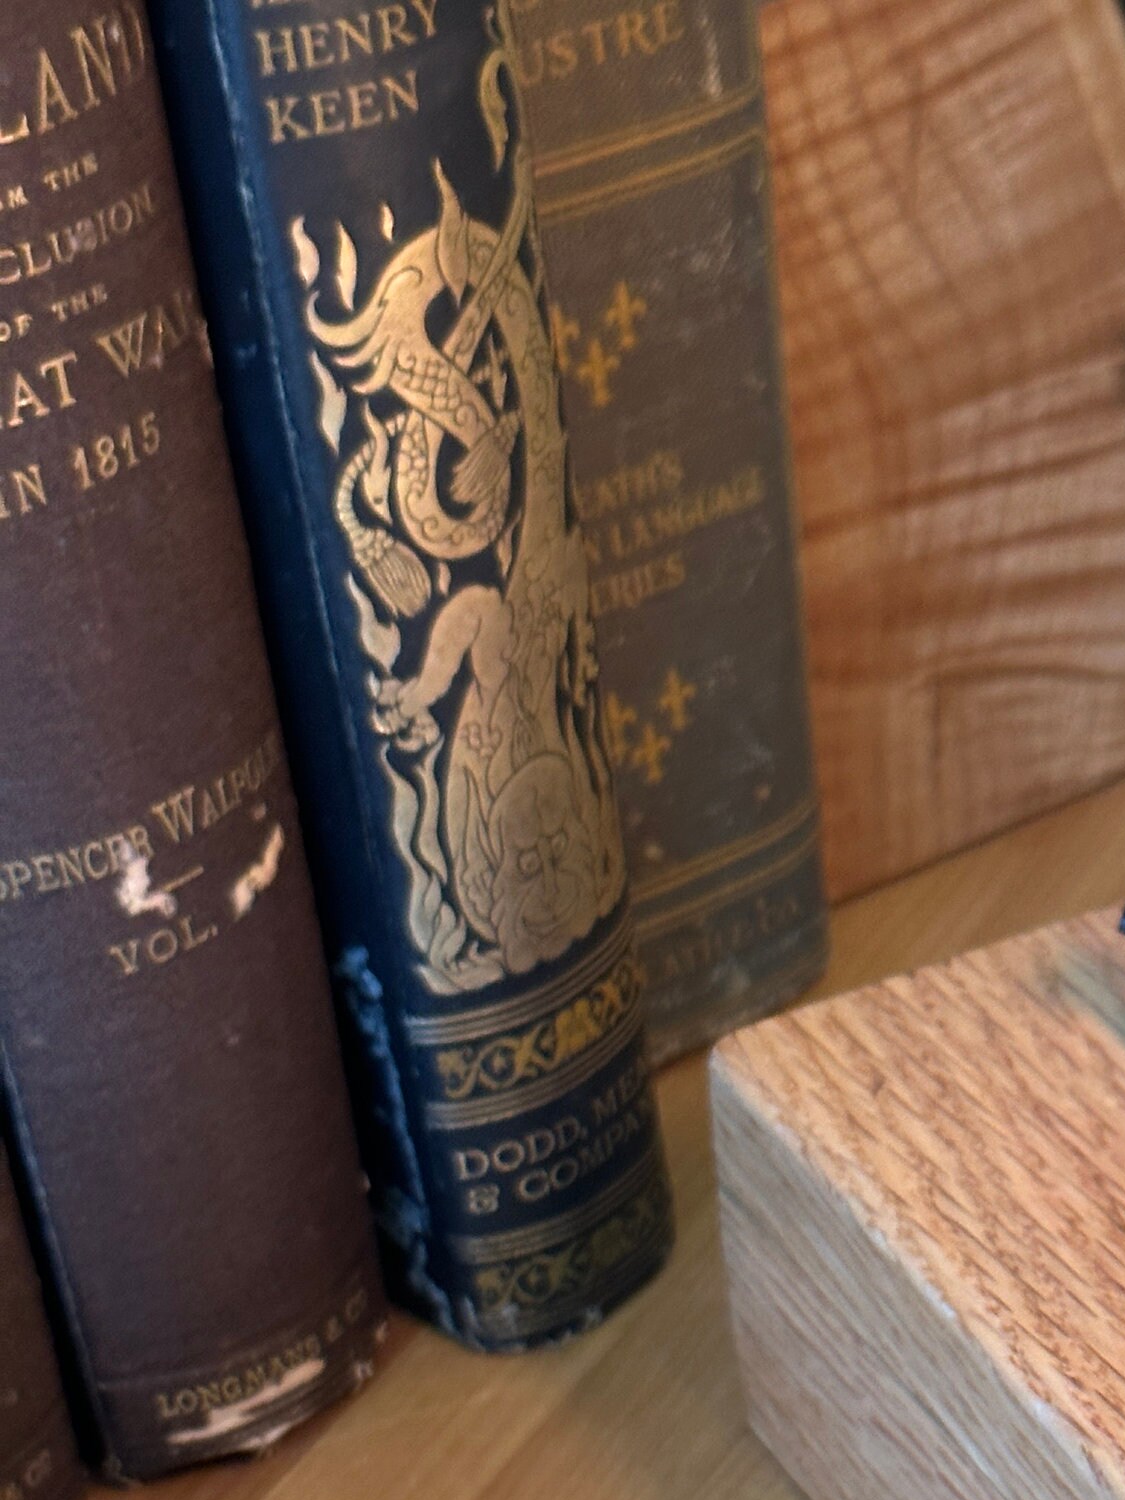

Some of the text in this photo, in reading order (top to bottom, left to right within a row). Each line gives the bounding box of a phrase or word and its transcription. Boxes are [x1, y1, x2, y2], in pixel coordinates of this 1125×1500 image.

[255, 0, 438, 77] HENRY
[266, 69, 419, 145] KEEN
[43, 152, 99, 192] THE
[51, 283, 108, 322] THE
[70, 411, 160, 490] 1815
[0, 824, 154, 899] PENCER
[110, 914, 218, 976] VOL.
